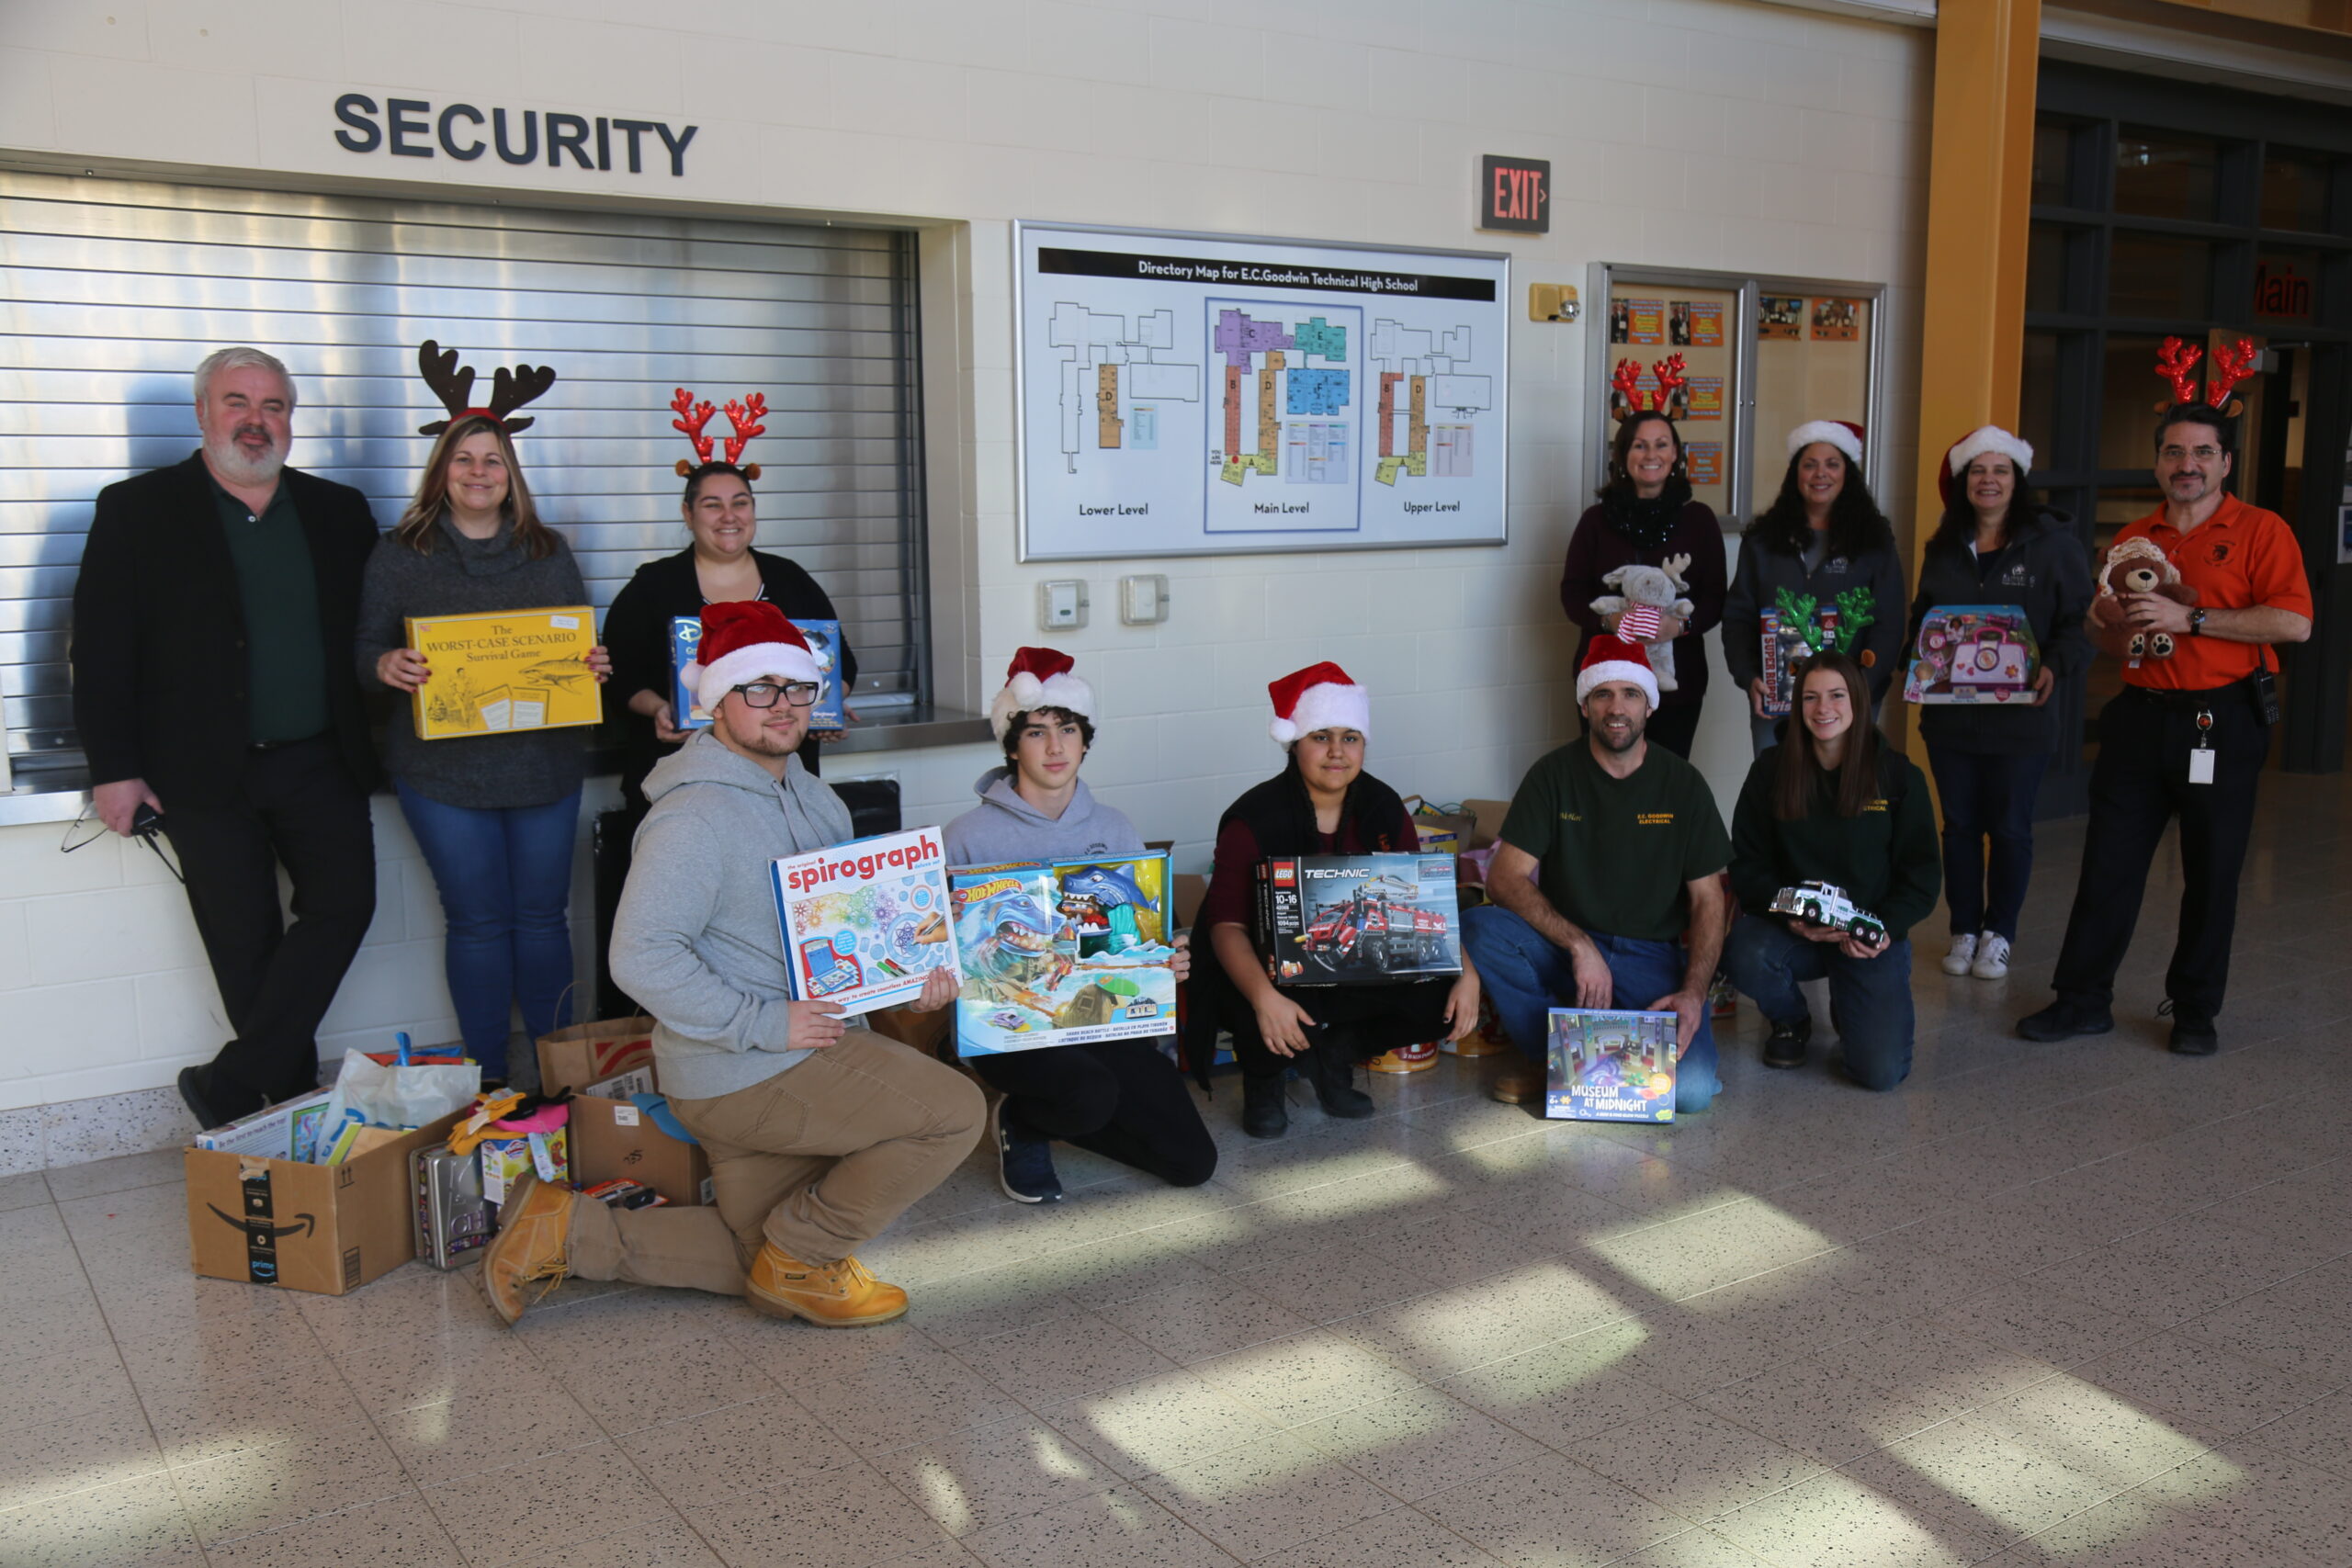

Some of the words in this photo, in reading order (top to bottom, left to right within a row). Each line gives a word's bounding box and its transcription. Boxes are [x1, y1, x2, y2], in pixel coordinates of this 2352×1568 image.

[334, 93, 698, 176] SECURITY
[1494, 167, 1543, 220] EXIT
[1138, 260, 1193, 279] Directory
[1195, 265, 1219, 281] Map
[1222, 265, 1238, 279] for
[1311, 272, 1359, 288] Technical
[1361, 276, 1383, 292] High
[1385, 277, 1418, 292] School
[1249, 329, 1256, 339] C
[1317, 331, 1323, 341] E
[1230, 379, 1237, 389] B
[1265, 380, 1272, 390] D
[1416, 384, 1421, 393] D
[1105, 391, 1113, 401] D
[1249, 457, 1255, 467] A
[1080, 503, 1114, 516] Lower
[1118, 502, 1148, 515] Level
[1254, 502, 1279, 513] Main
[1282, 502, 1309, 513] Level
[1404, 501, 1432, 514] Upper
[1435, 501, 1460, 513] Level
[491, 625, 513, 635] The
[426, 637, 511, 652] WORST-CASE
[512, 632, 577, 646] SCENARIO
[467, 650, 508, 662] Survival
[510, 649, 541, 660] Game
[1764, 637, 1776, 671] SUPER
[787, 834, 939, 894] spirograph
[1274, 869, 1294, 879] LEGO
[1305, 868, 1370, 879] TECHNIC
[1275, 894, 1297, 905] 10-16
[1571, 1085, 1619, 1098] MUSEUM
[1584, 1098, 1594, 1108] AT
[1595, 1098, 1647, 1112] MIDNIGHT
